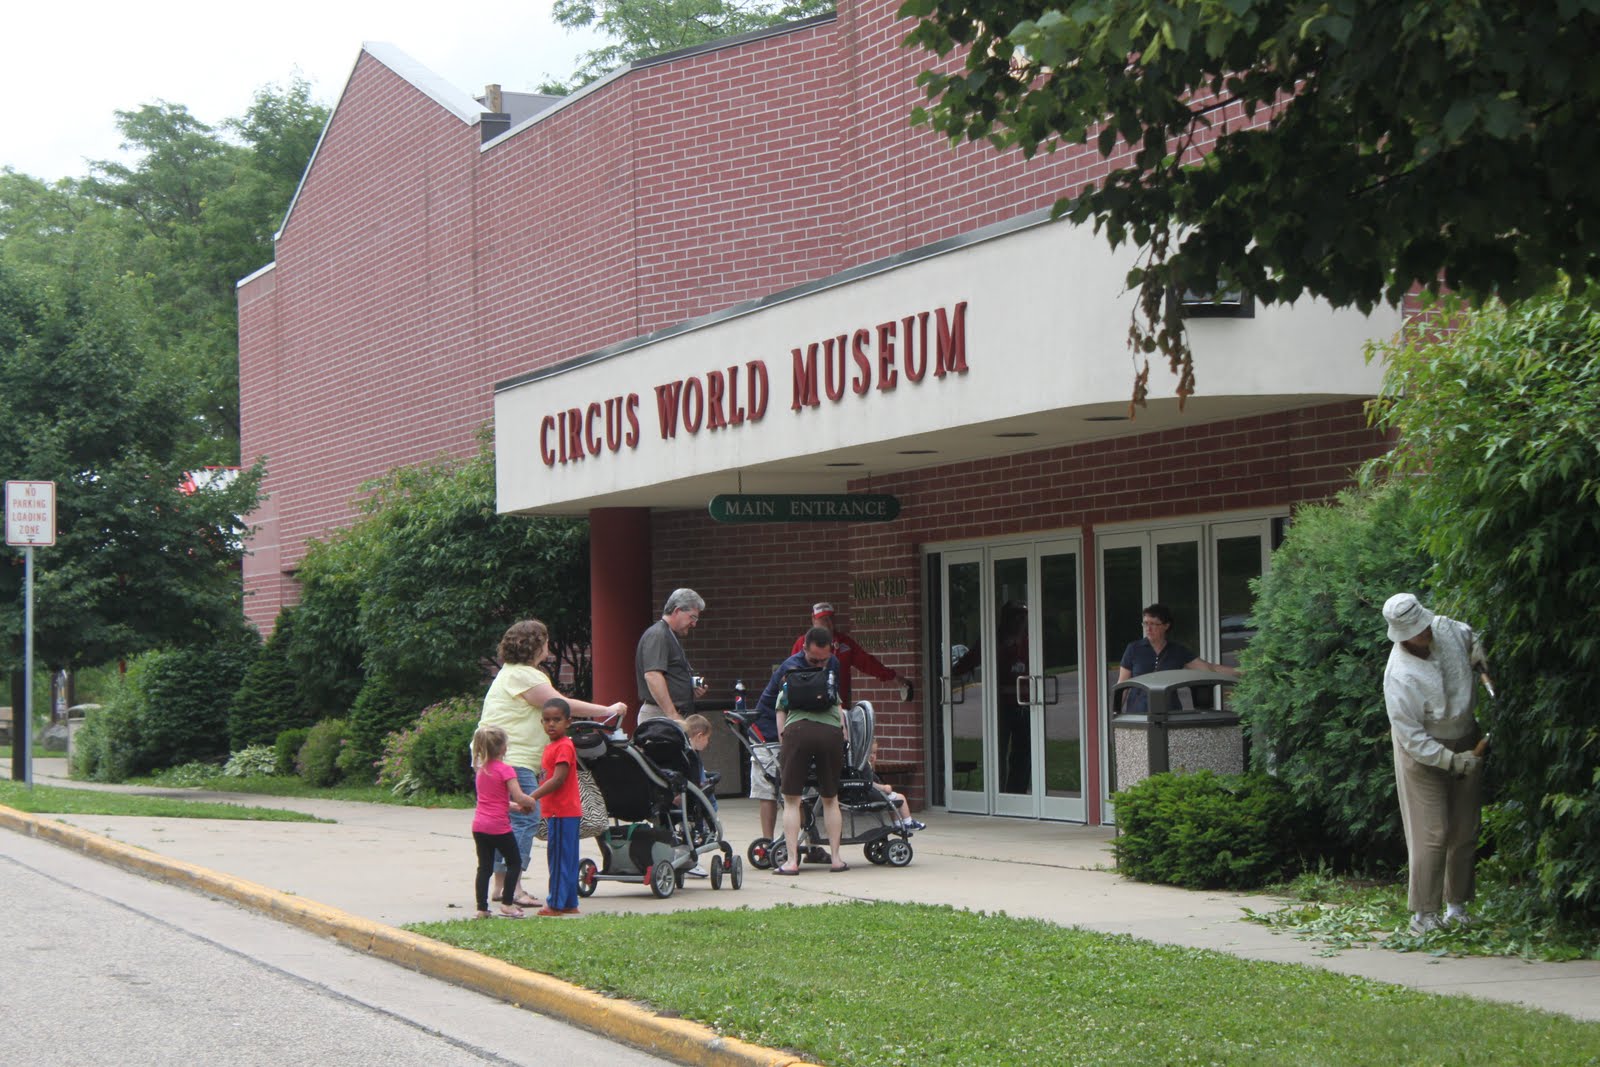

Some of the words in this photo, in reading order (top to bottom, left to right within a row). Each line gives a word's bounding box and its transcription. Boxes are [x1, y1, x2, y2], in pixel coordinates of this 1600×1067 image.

[540, 393, 640, 465] CIRCUS
[655, 359, 769, 438] WORLD
[791, 301, 967, 410] MUSEUM
[25, 487, 36, 497] NO
[13, 499, 46, 509] PARKING
[725, 501, 774, 516] MAIN
[791, 500, 887, 515] ENTRANCE
[12, 512, 47, 522] LOADING
[19, 525, 40, 535] ZONE
